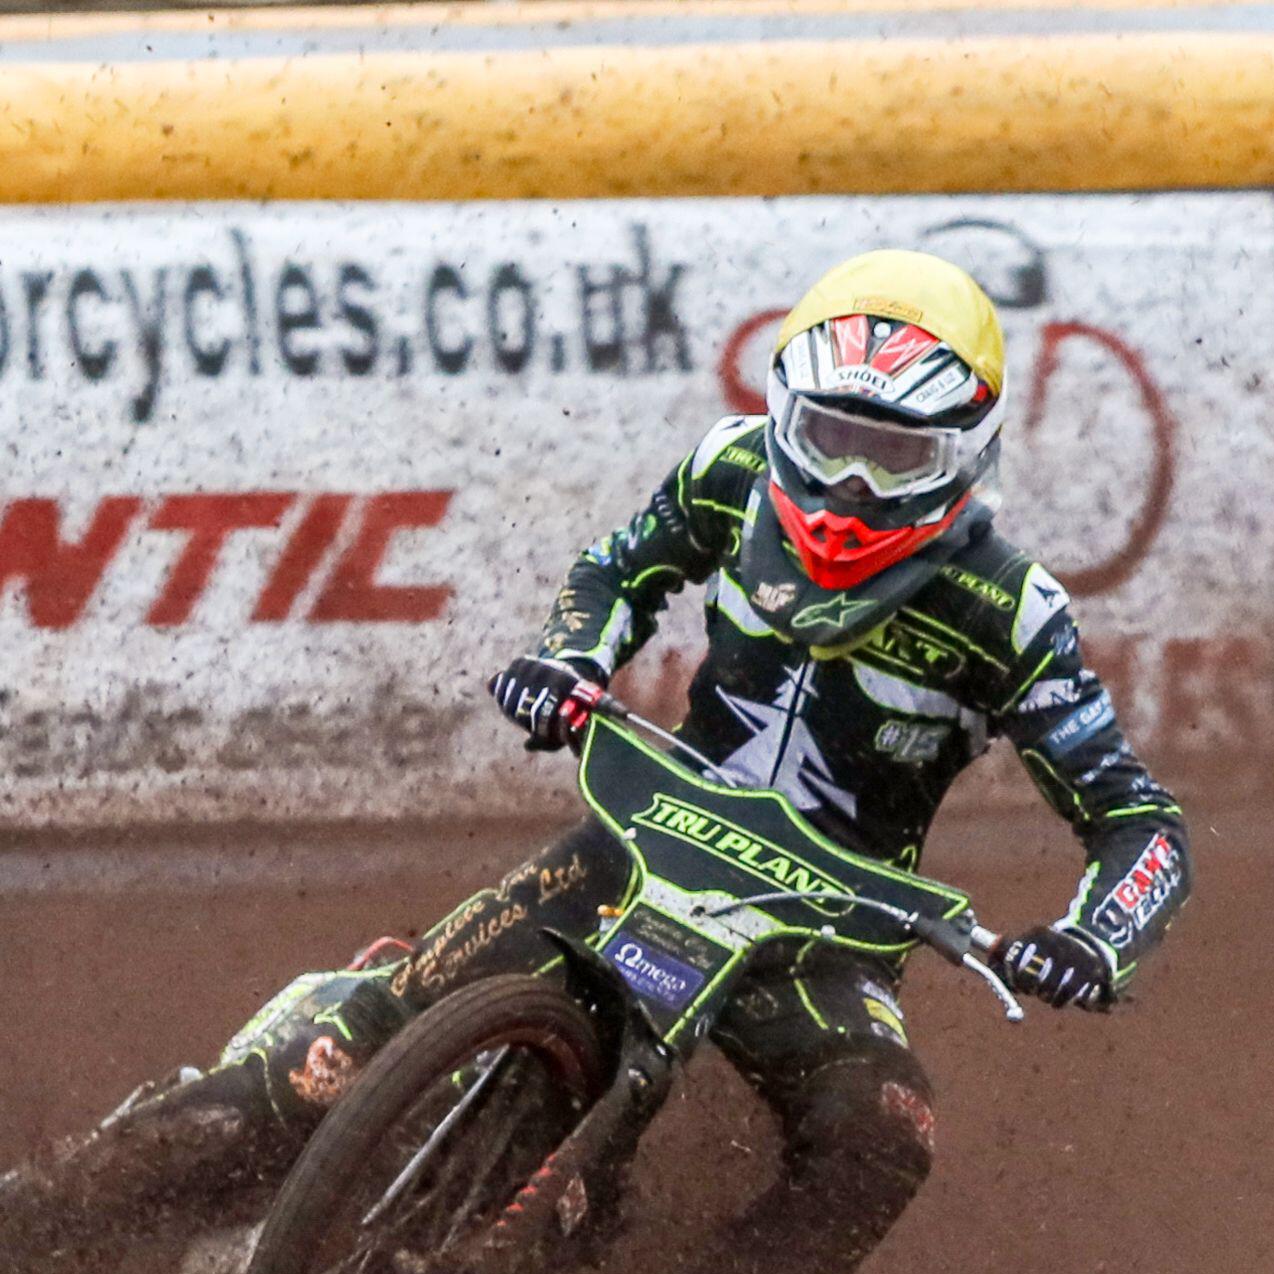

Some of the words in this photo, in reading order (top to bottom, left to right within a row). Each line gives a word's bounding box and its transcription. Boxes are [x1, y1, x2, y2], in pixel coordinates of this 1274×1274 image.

[0, 222, 695, 424] rcycles.co.uk
[653, 801, 721, 841] TRU
[715, 827, 843, 904] PLANT
